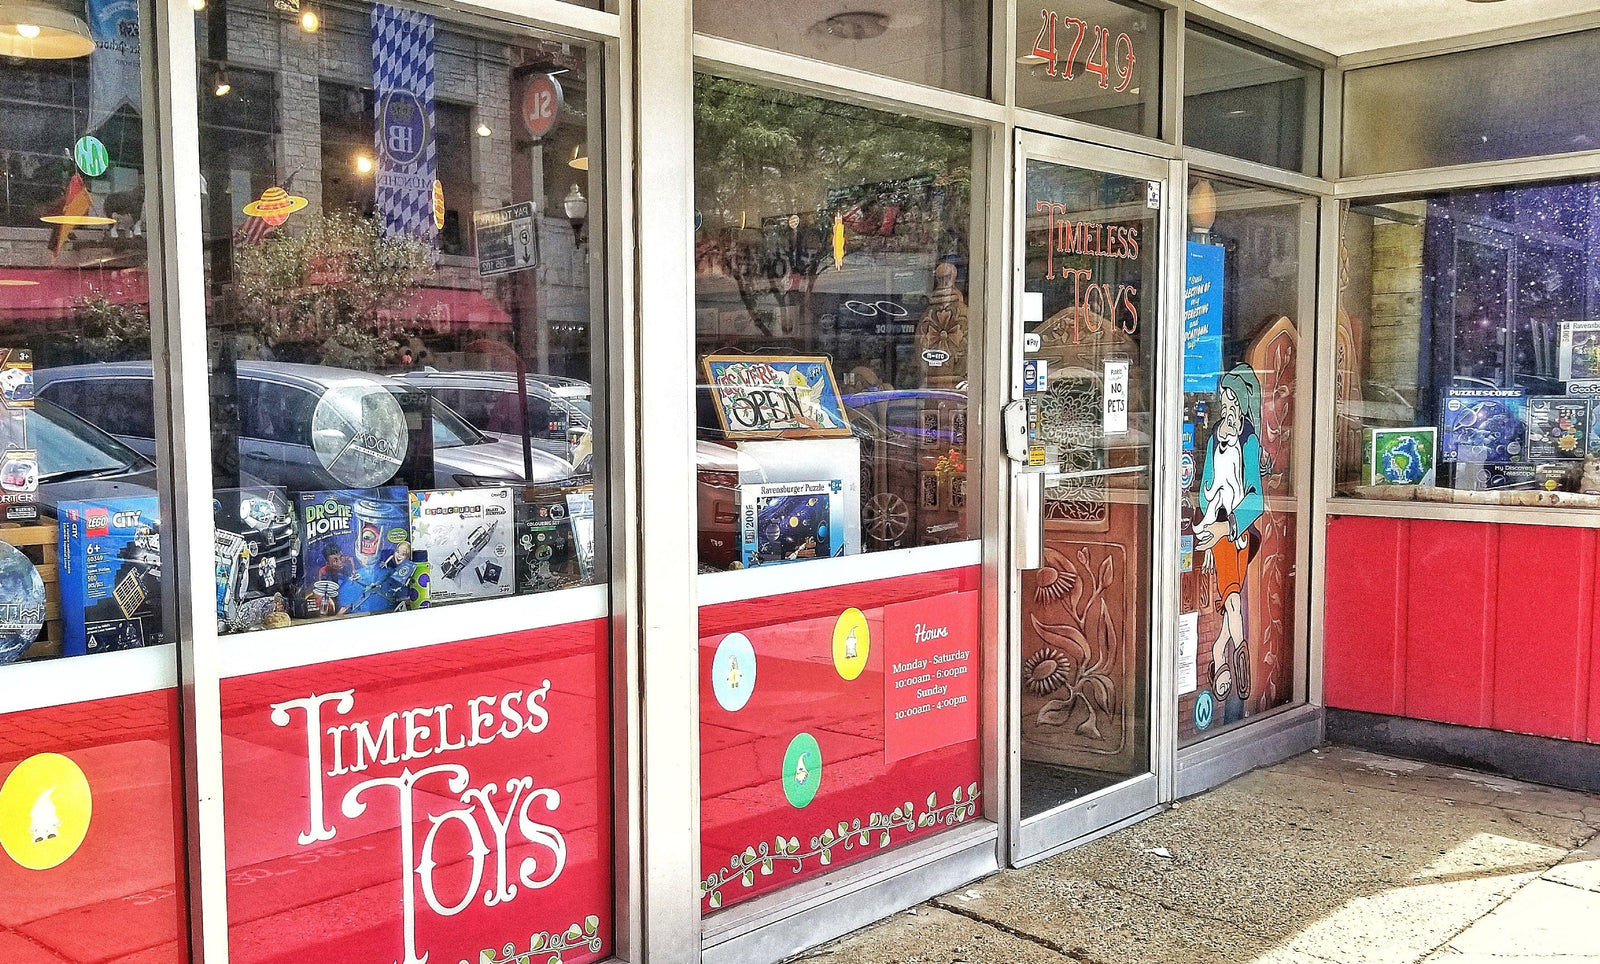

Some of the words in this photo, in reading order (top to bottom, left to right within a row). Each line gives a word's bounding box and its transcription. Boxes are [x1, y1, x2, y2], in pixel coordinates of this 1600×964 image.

[1032, 9, 1136, 92] 4749
[1036, 199, 1139, 281] TIMELESS
[1062, 266, 1138, 345] TOYS
[19, 352, 30, 361] 3+
[1110, 382, 1123, 394] NO
[1449, 389, 1522, 397] PUZZLESCOPES
[732, 386, 804, 428] OPEN
[1107, 399, 1125, 414] PETS
[760, 485, 804, 495] Ravensburger
[805, 483, 825, 492] Puzzle
[112, 510, 142, 528] CITY
[306, 500, 352, 522] DRONE
[745, 510, 755, 528] 200
[88, 516, 107, 529] LEGO
[307, 517, 350, 540] HOME
[87, 543, 101, 554] 6+
[914, 623, 949, 644] Hours
[892, 659, 928, 675] Monday
[932, 649, 971, 665] Saturday
[895, 673, 931, 689] 10:00am
[936, 665, 968, 679] 6:00pm
[916, 684, 948, 699] Sunday
[895, 703, 931, 720] 10:00am
[936, 695, 968, 710] 4:00pm
[269, 680, 552, 846] TIMELESS
[341, 763, 568, 964] TOYS
